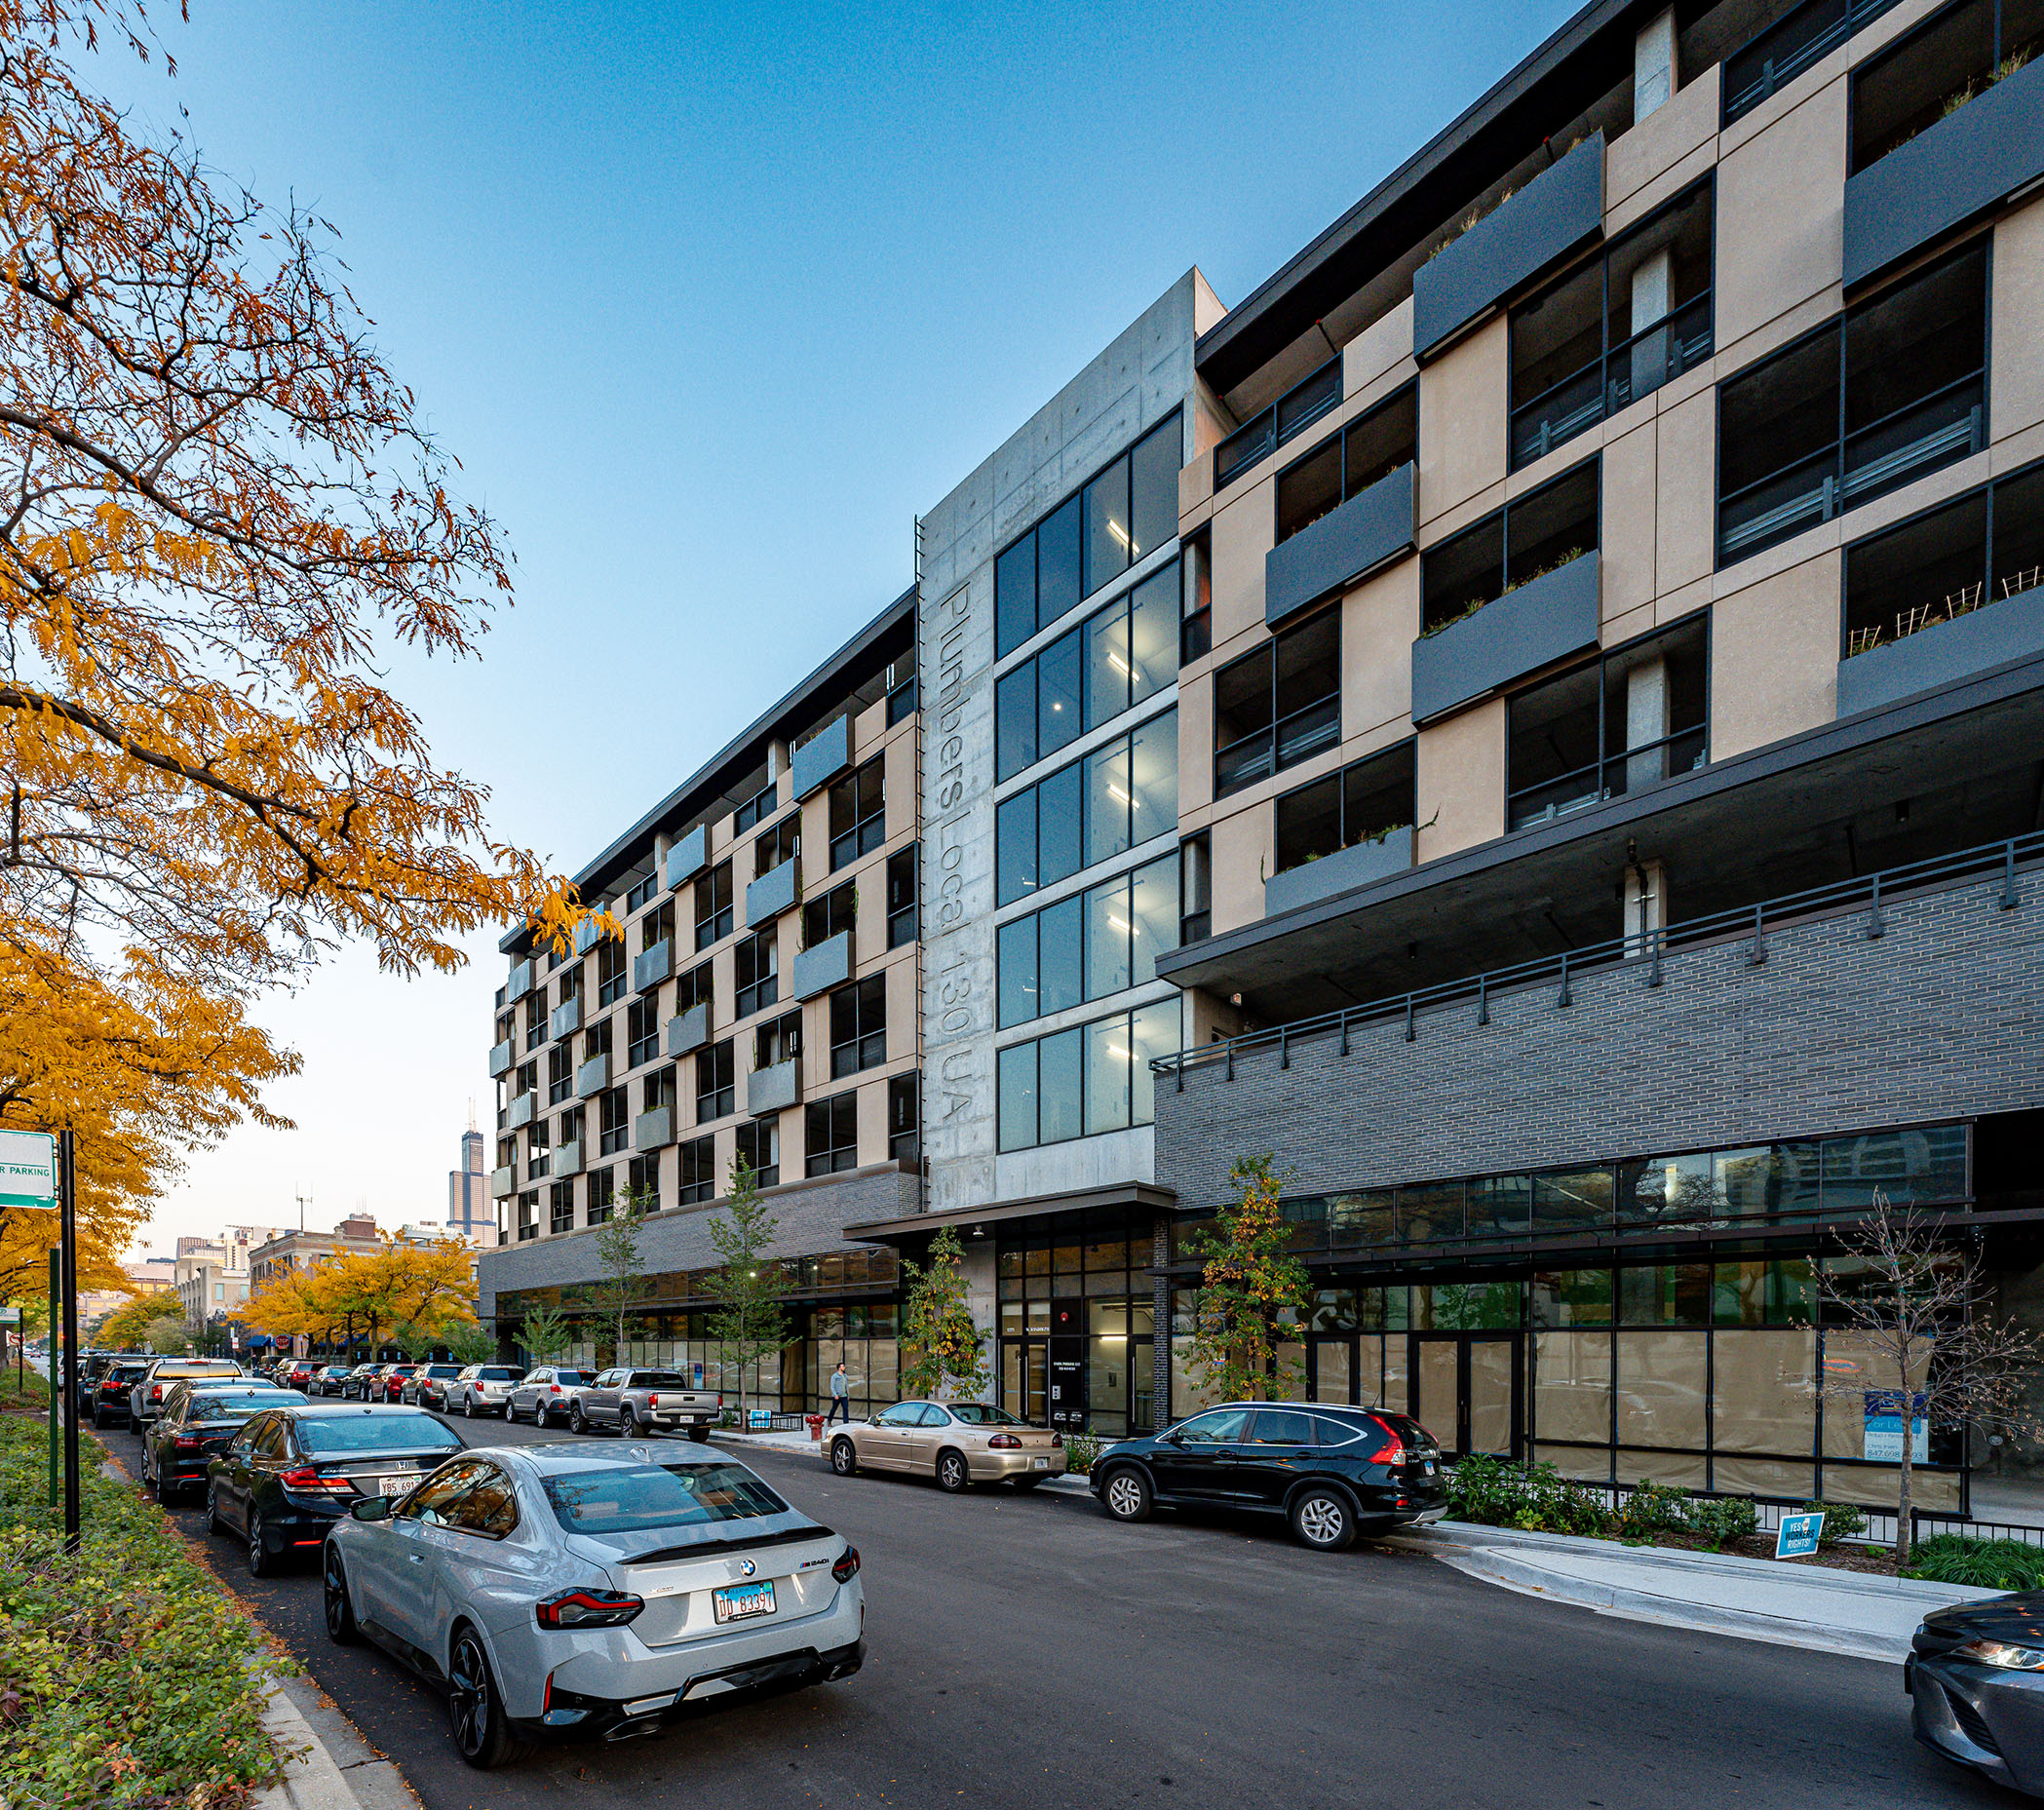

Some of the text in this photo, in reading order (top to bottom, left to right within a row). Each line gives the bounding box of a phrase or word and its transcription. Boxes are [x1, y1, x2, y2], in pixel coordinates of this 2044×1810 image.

[939, 580, 973, 1119] Plumbers Local 130 UA
[10, 1166, 50, 1177] PARKING
[382, 1483, 397, 1492] Y85
[1790, 1521, 1802, 1532] YES
[1787, 1538, 1811, 1550] RIGHTS!
[718, 1598, 734, 1617] DD
[739, 1591, 772, 1613] 83397
